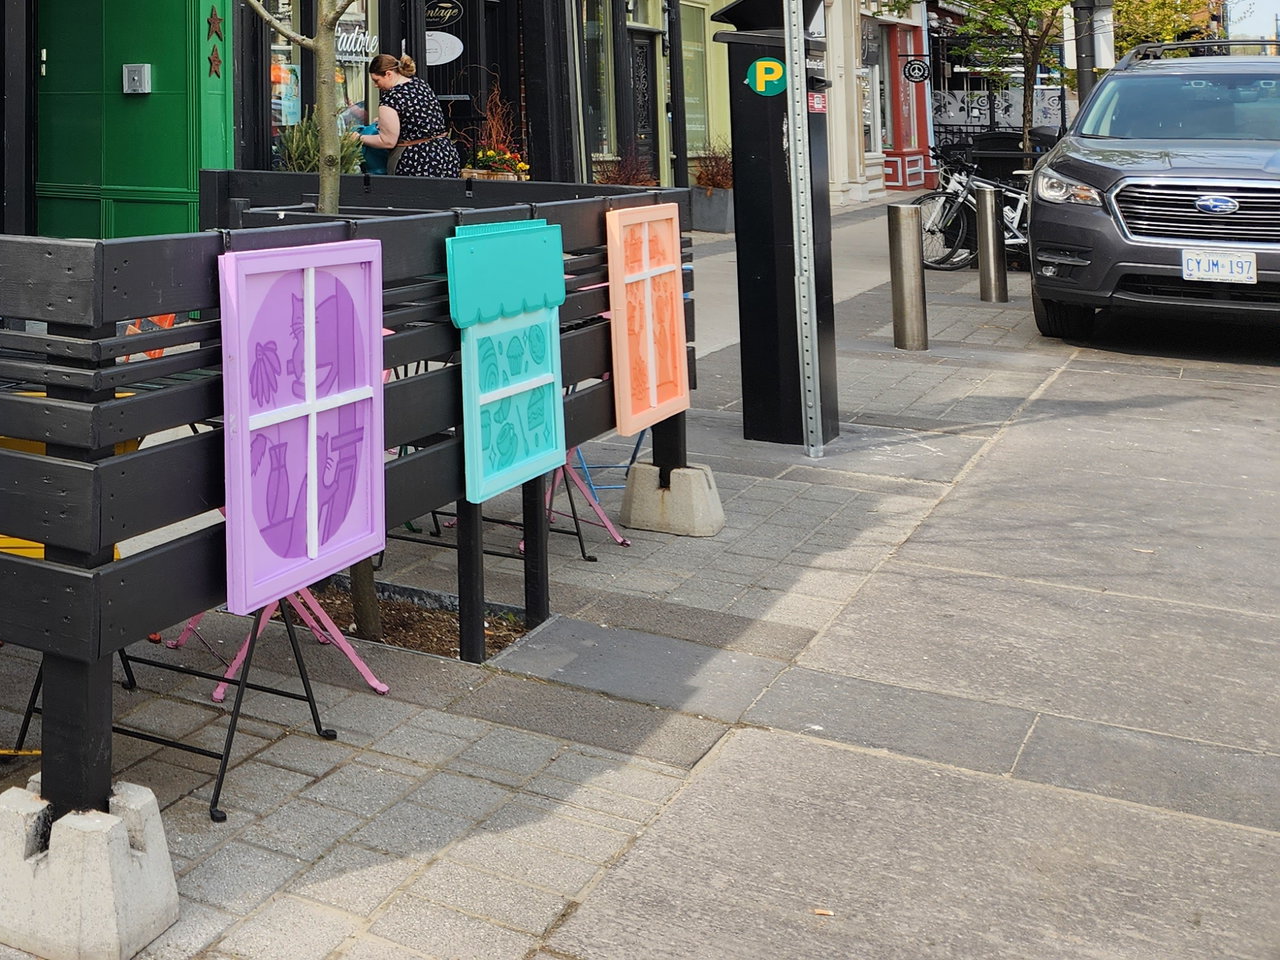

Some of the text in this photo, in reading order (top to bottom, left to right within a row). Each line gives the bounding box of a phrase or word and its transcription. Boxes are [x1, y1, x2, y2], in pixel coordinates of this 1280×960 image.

[756, 61, 783, 91] P
[1186, 258, 1252, 275] CYJM 197
